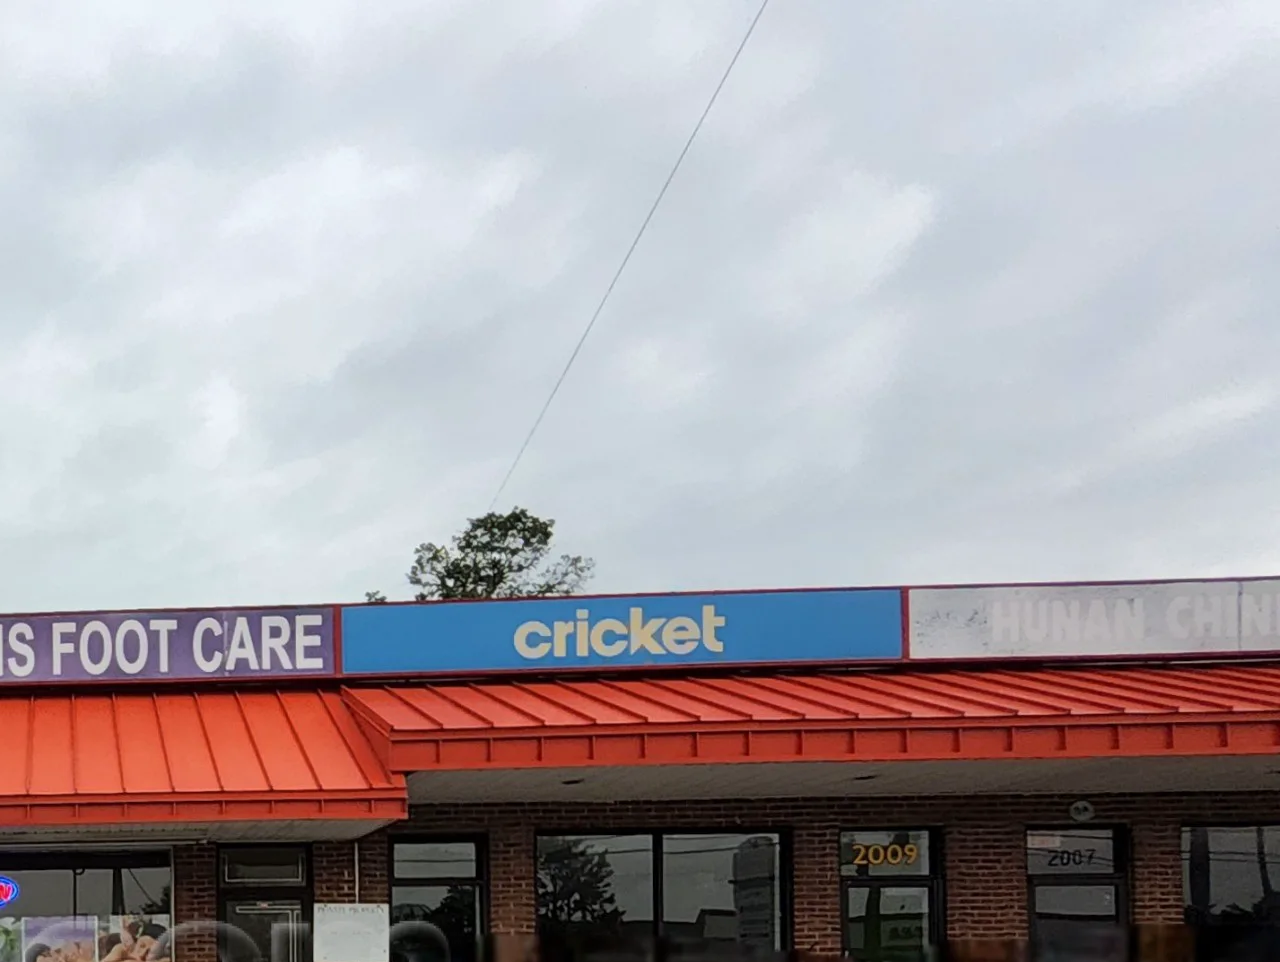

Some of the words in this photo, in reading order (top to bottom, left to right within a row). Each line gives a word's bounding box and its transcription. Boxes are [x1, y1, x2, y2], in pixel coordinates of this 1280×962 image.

[513, 604, 726, 659] cricket
[991, 598, 1145, 643] HUNAN
[1169, 593, 1280, 640] CHIN
[51, 619, 178, 676] FOOT
[192, 614, 324, 673] CARE
[851, 843, 919, 866] 2009
[1046, 848, 1097, 867] 2007
